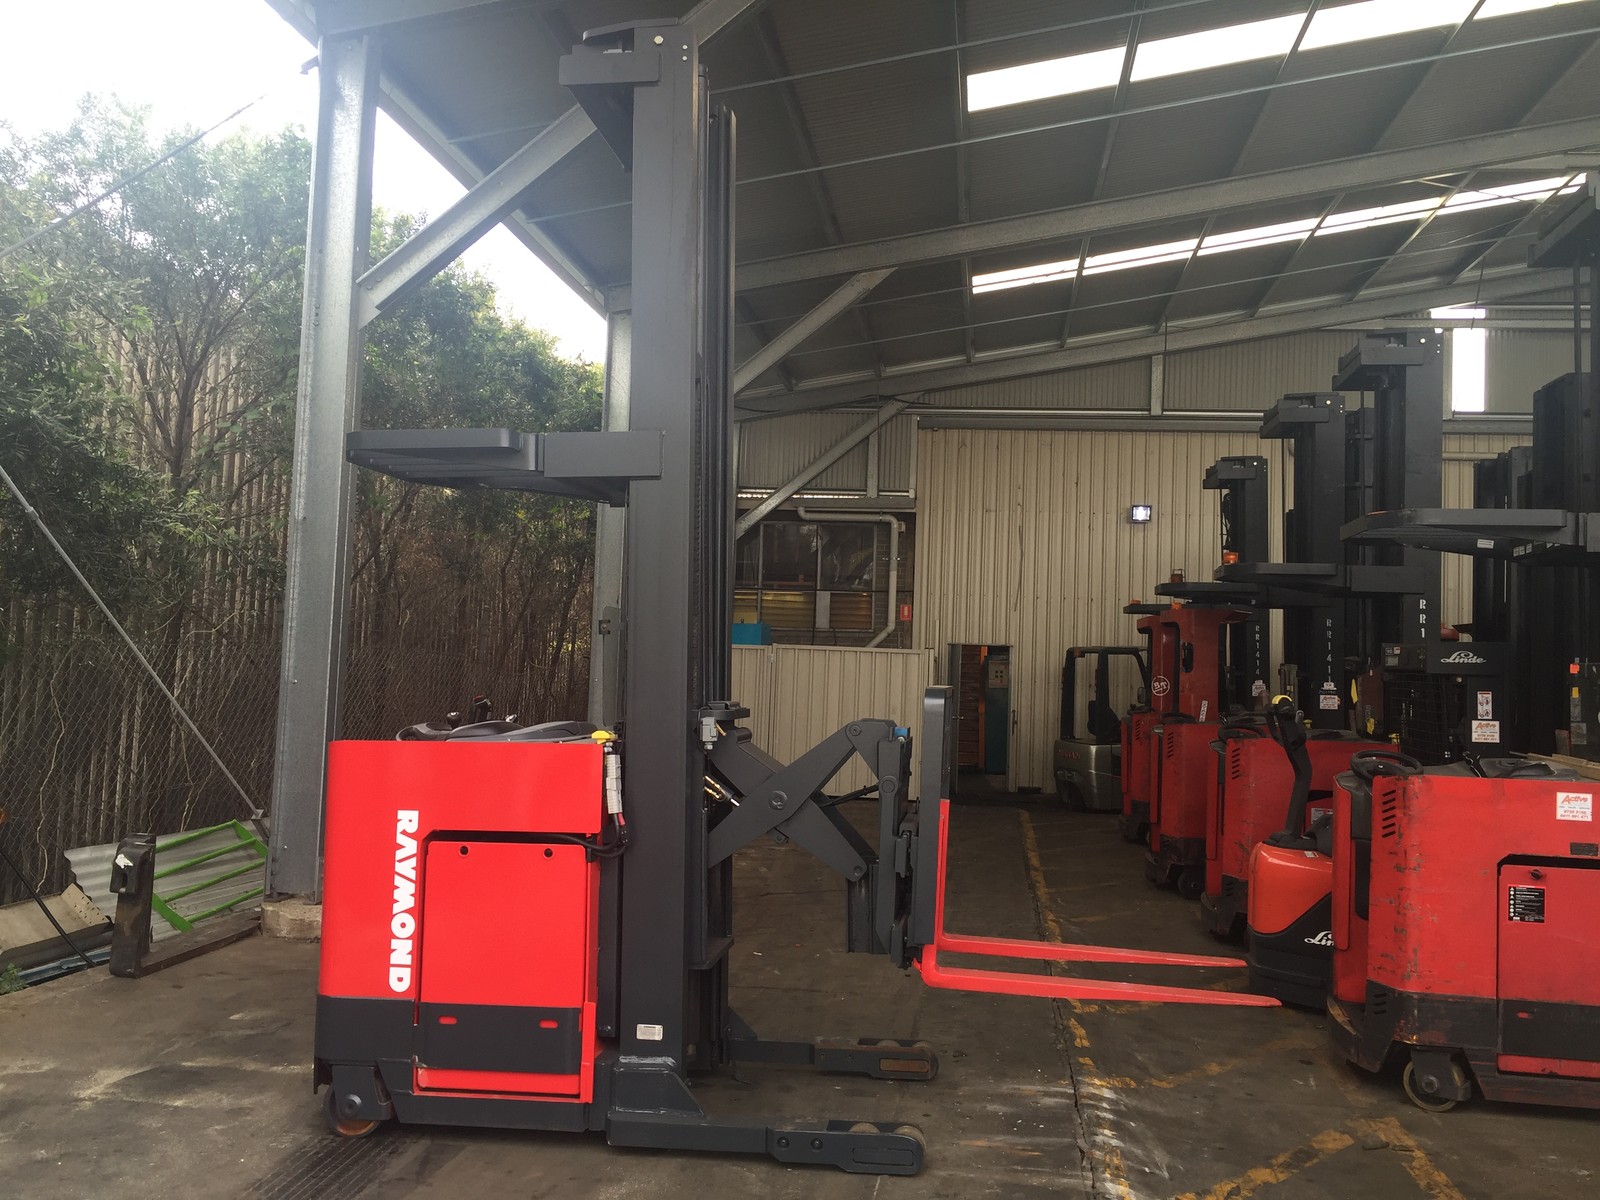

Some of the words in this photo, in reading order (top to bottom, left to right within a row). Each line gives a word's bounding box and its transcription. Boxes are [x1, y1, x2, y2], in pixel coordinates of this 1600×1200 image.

[1440, 650, 1486, 664] Linde
[1561, 795, 1588, 804] Active
[389, 810, 419, 992] RAYMOND
